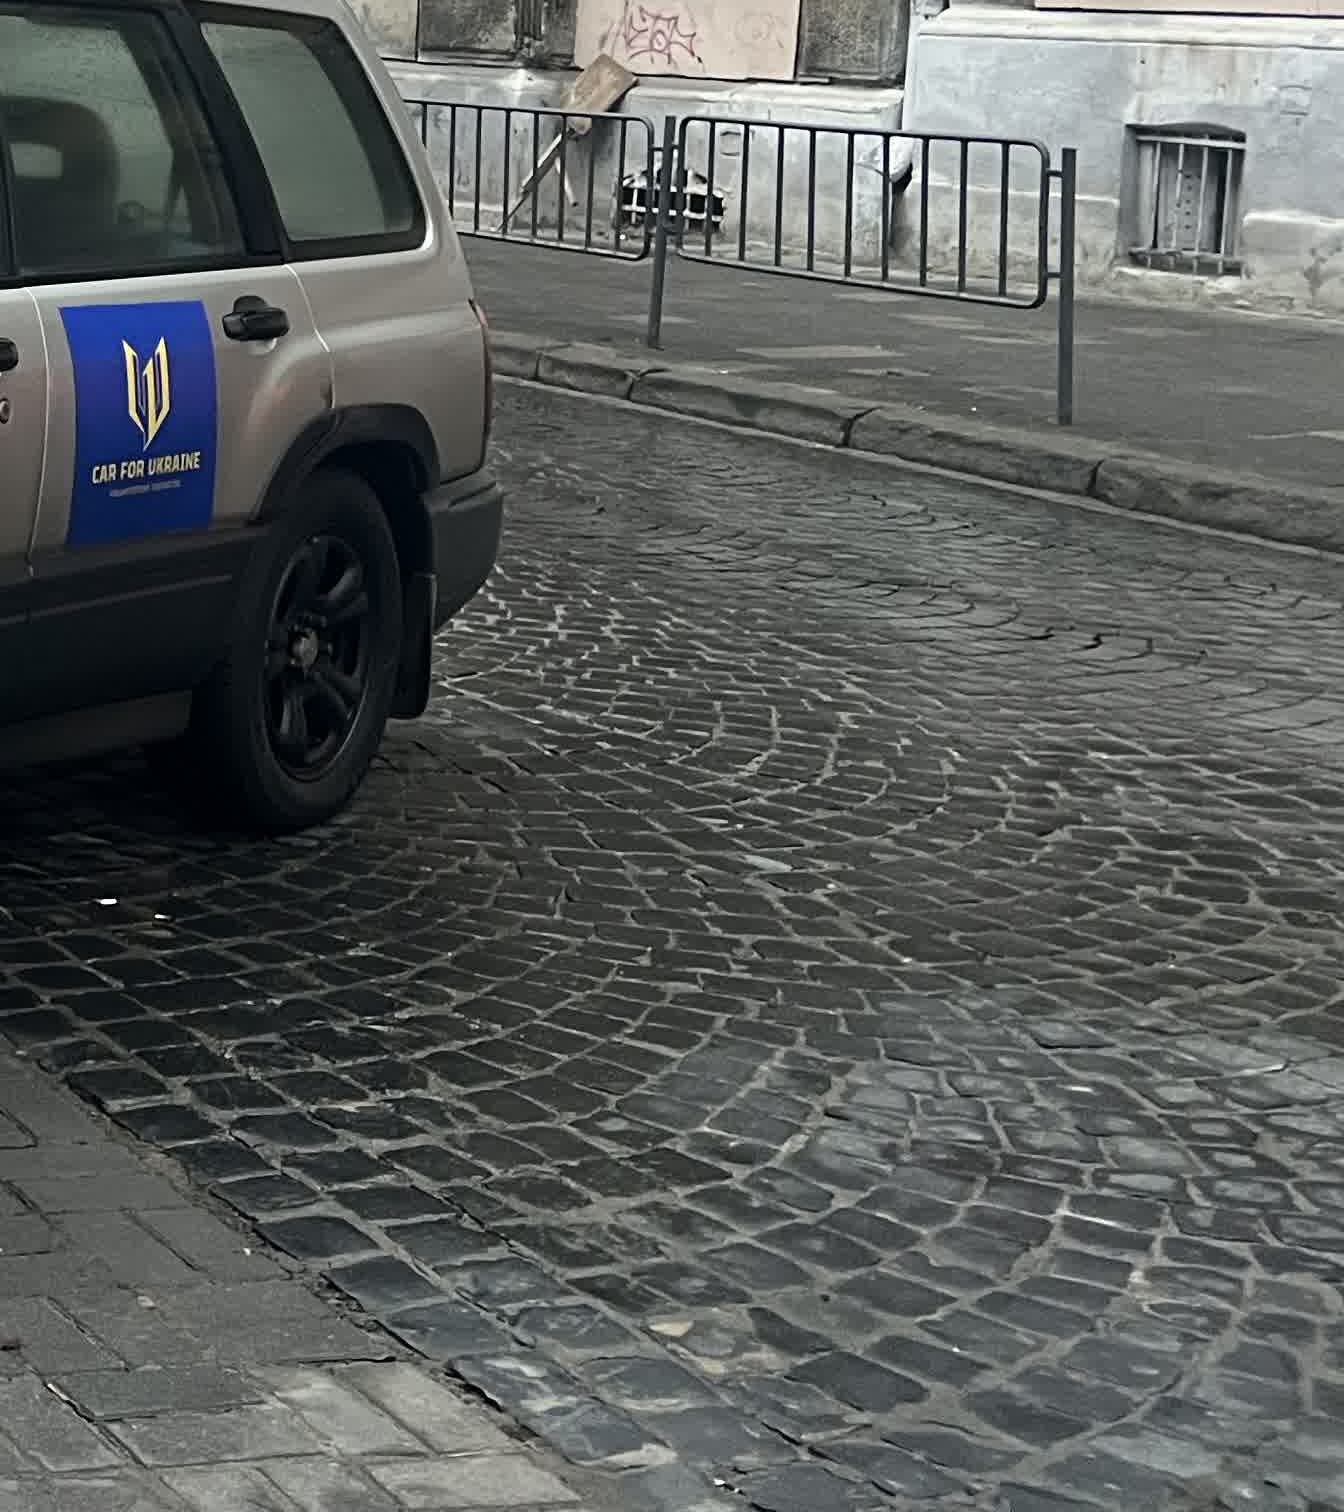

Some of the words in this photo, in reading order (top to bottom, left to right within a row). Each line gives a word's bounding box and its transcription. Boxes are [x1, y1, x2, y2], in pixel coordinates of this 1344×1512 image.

[92, 463, 116, 484] CAR
[120, 459, 145, 480] FOR
[148, 451, 201, 476] UKRAINE
